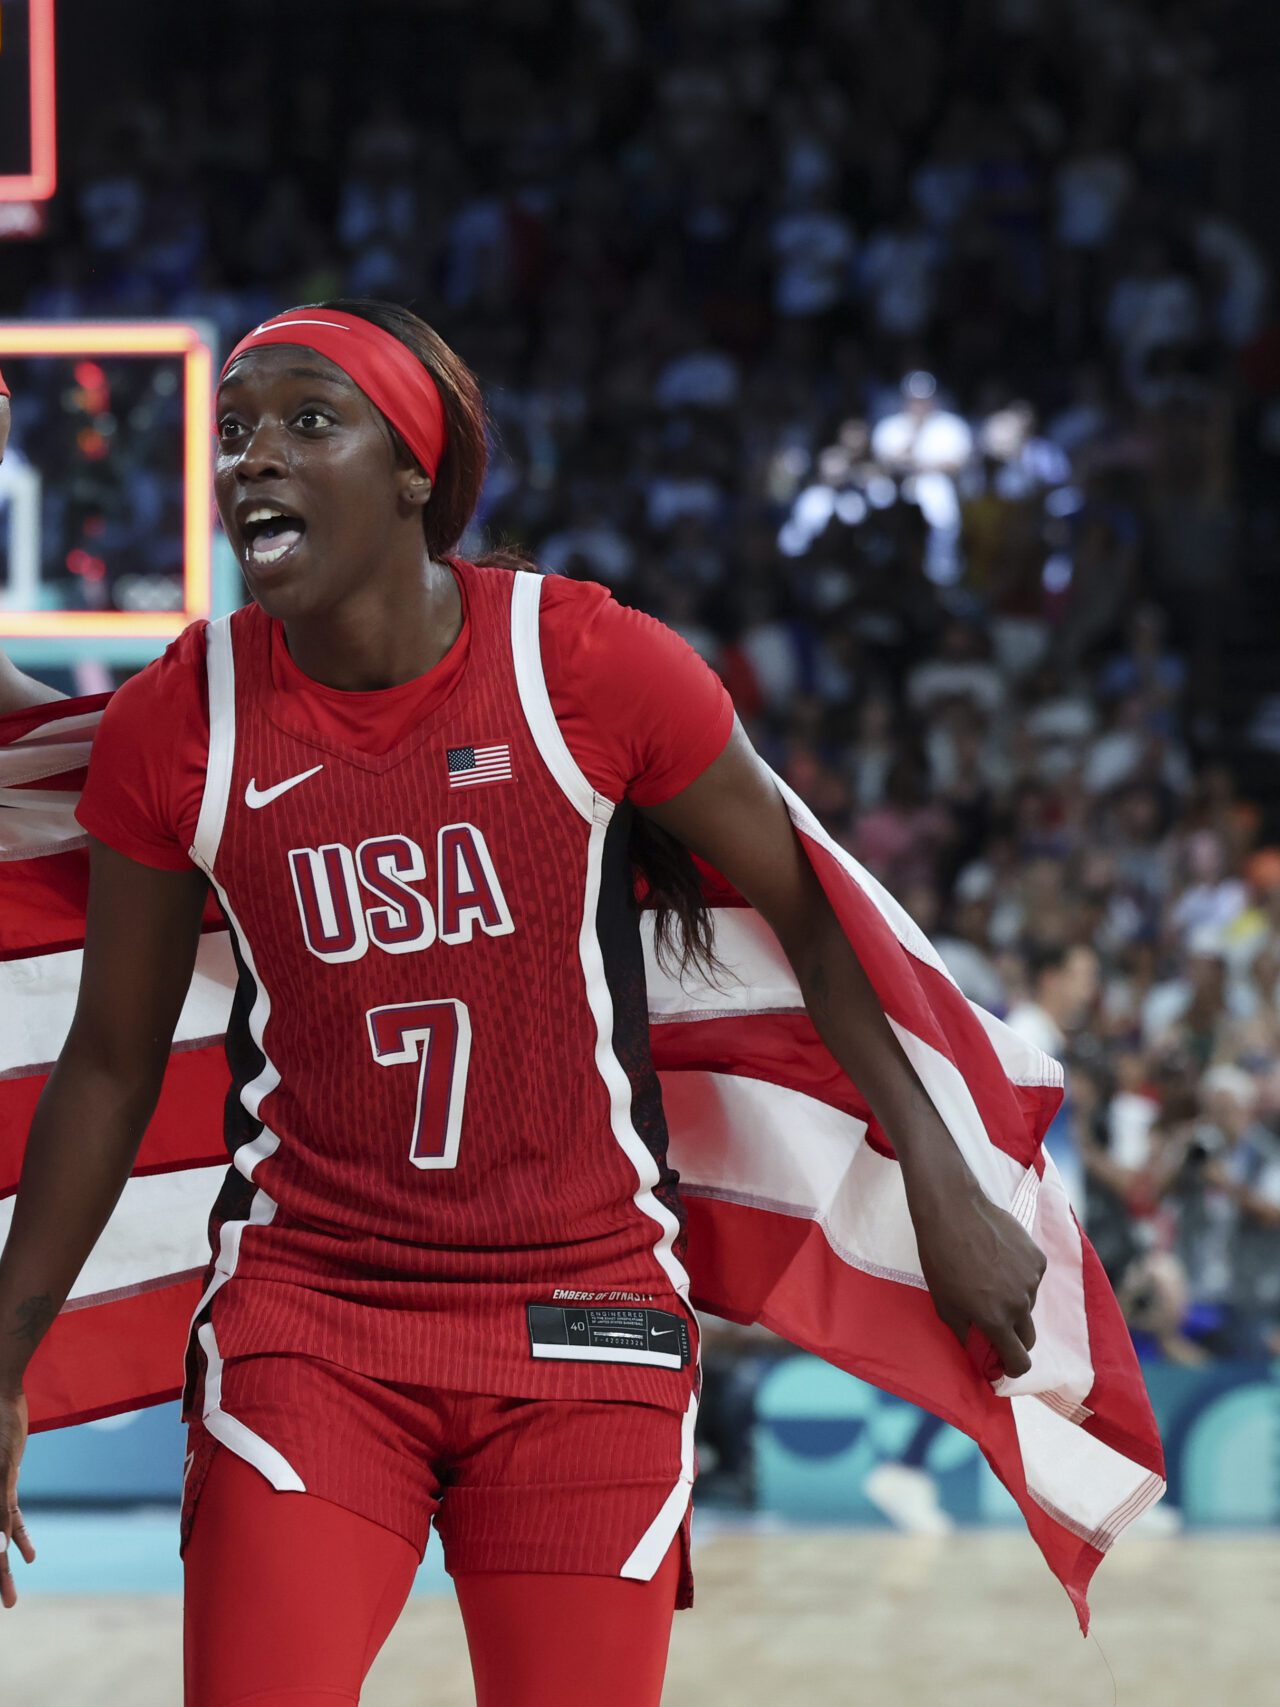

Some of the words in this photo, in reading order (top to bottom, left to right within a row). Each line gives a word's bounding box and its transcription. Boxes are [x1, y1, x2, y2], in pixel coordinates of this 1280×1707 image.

[288, 822, 515, 964] USA
[365, 998, 472, 1170] 7
[552, 1289, 595, 1301] EMBERS
[595, 1292, 609, 1301] OF
[570, 1322, 585, 1332] 40
